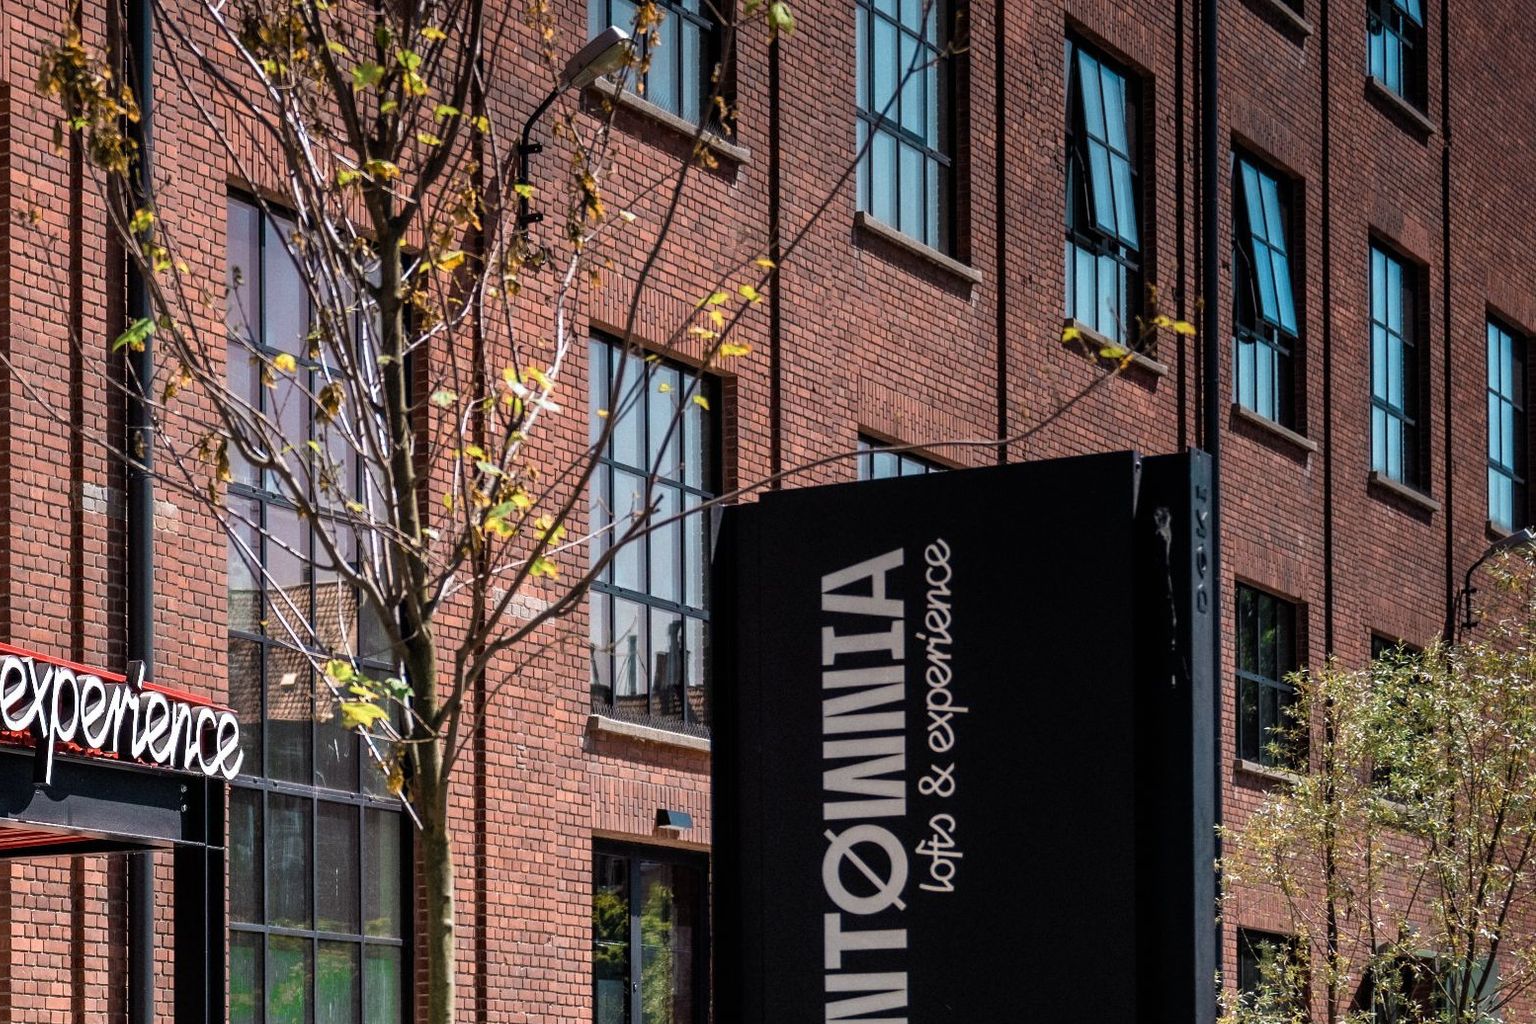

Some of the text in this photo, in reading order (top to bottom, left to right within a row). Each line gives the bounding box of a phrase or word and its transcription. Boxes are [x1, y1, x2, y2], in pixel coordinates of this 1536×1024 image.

[915, 538, 969, 892] lofts & experience
